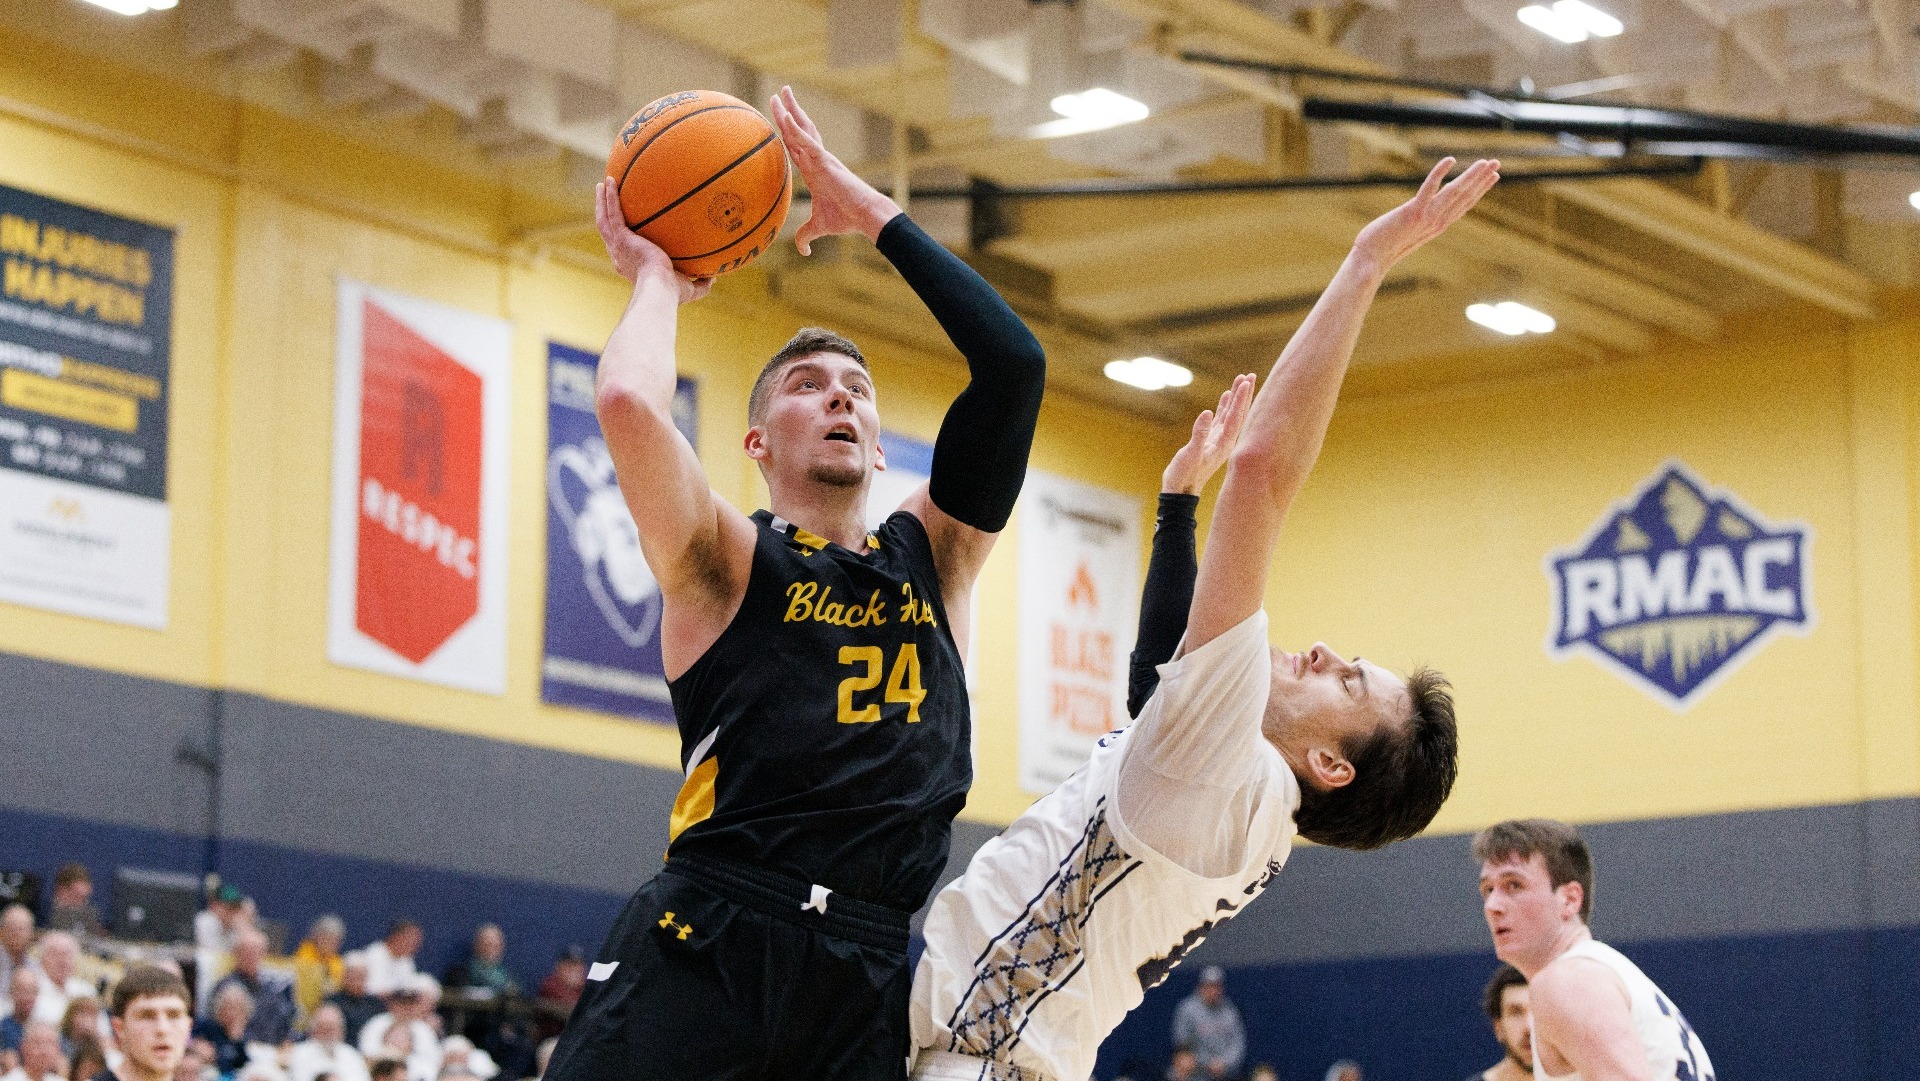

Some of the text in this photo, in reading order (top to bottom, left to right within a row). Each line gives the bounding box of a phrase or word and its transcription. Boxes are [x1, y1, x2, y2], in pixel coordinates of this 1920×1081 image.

[621, 91, 700, 146] NCAA
[4, 258, 145, 327] HAPPEN
[363, 477, 476, 578] RESPEC
[784, 581, 887, 628] Black
[1562, 539, 1796, 637] RMAC
[837, 642, 927, 724] 24
